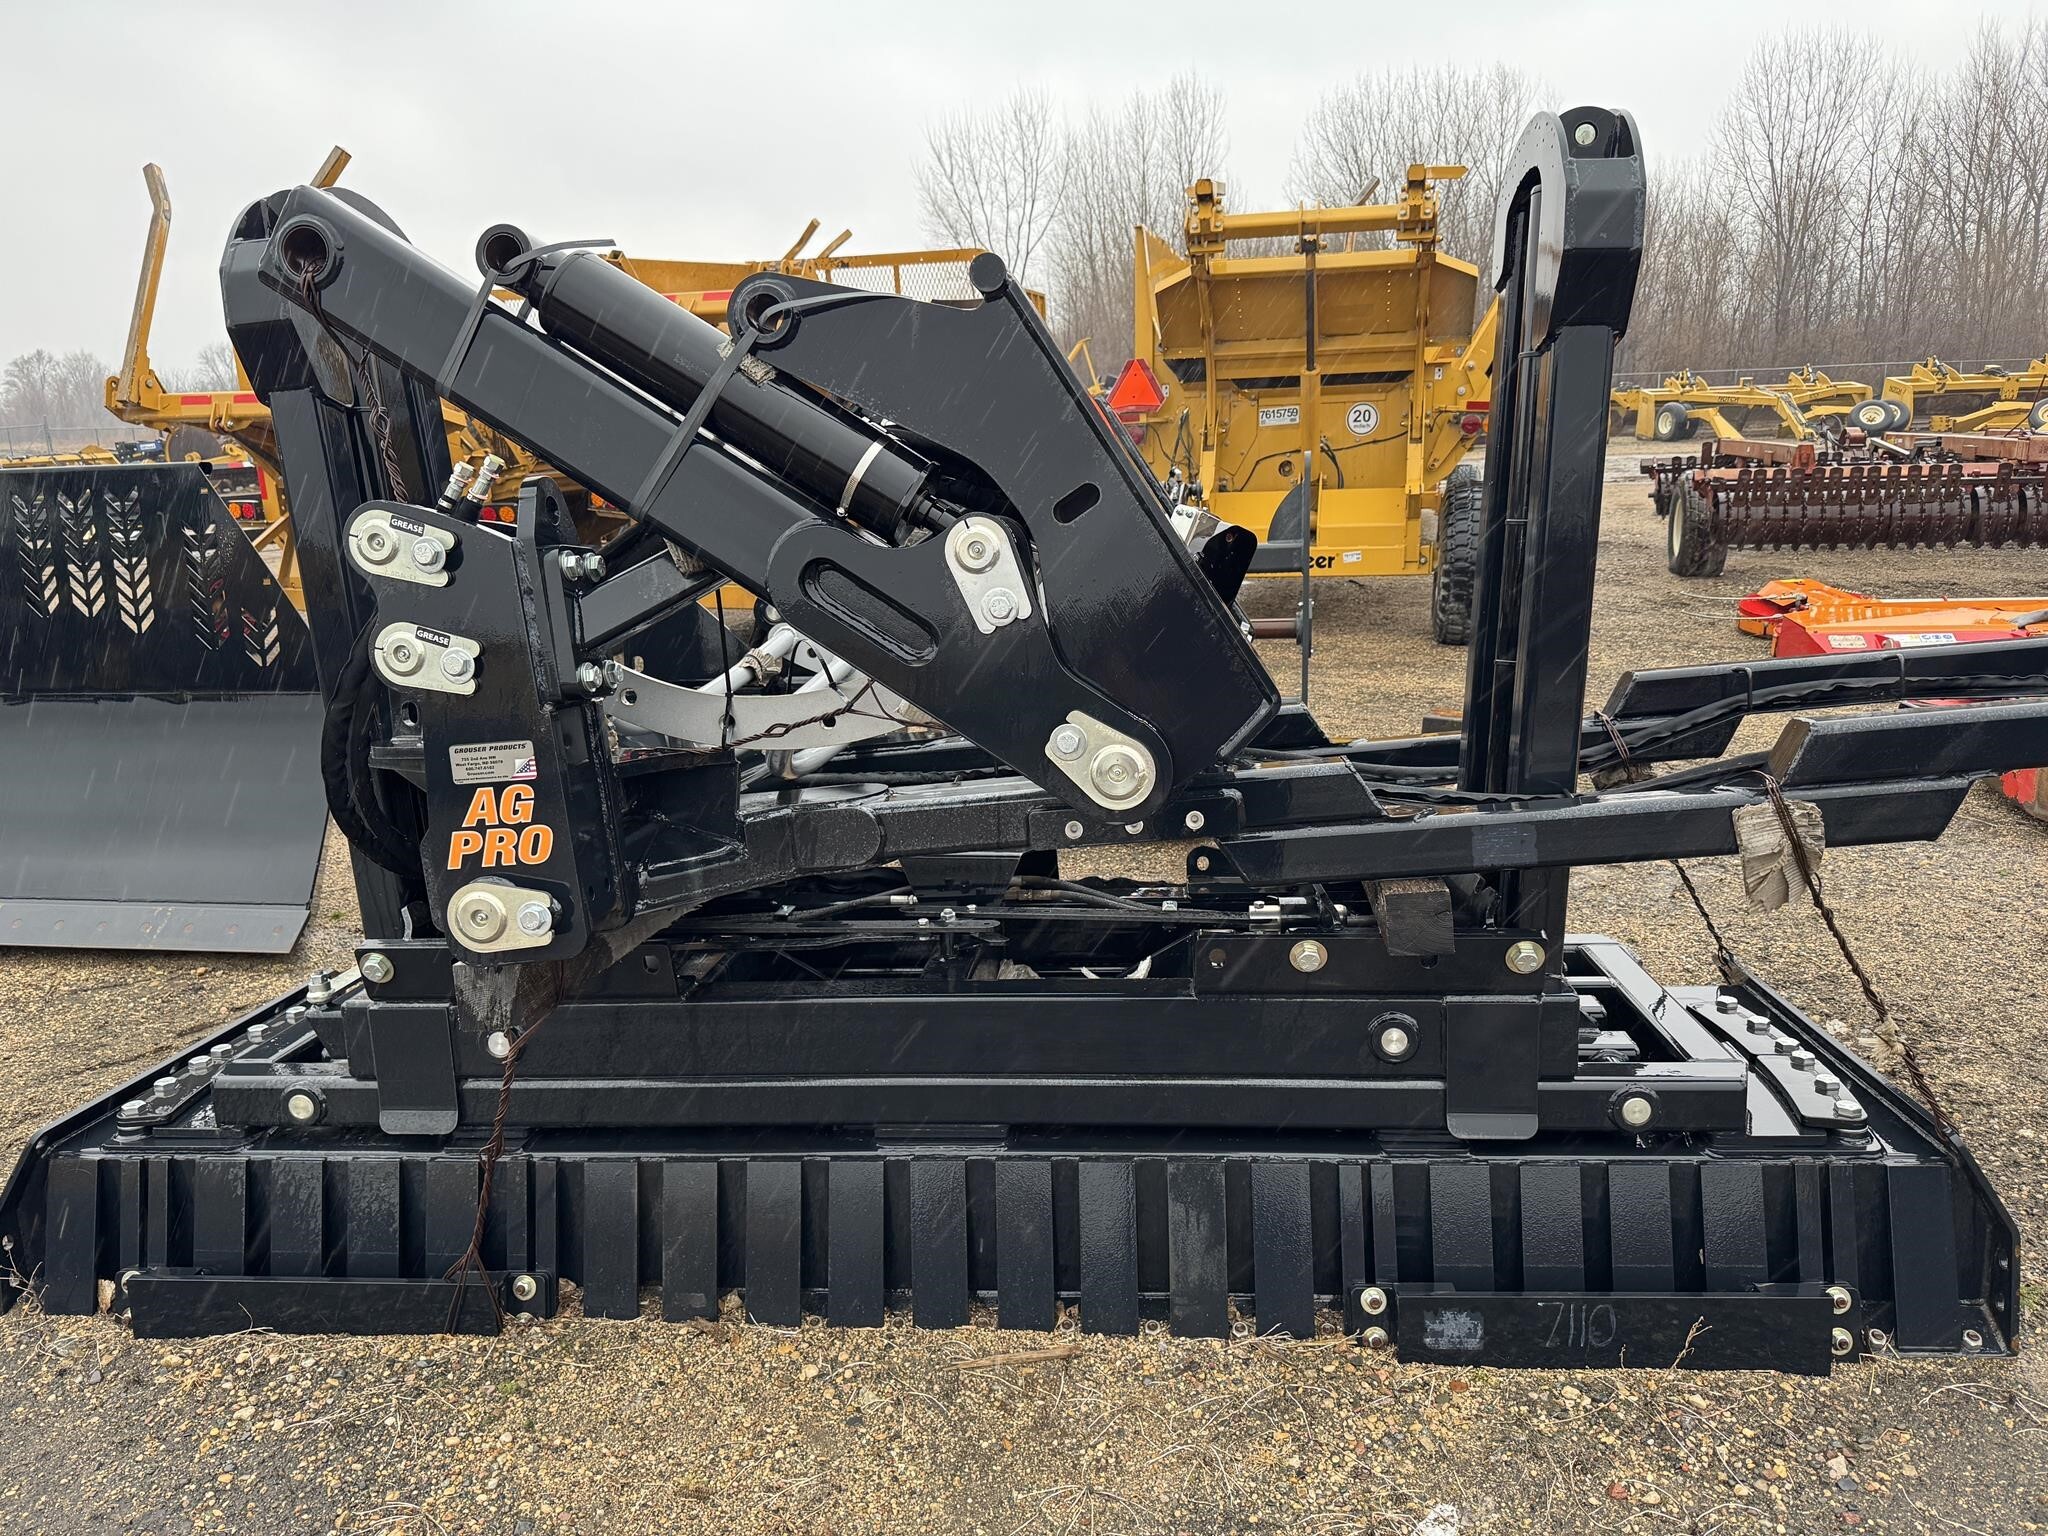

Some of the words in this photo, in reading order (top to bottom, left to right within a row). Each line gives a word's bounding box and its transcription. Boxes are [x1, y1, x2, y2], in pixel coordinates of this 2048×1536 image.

[1259, 407, 1298, 420] 7615759
[1352, 409, 1371, 423] 20
[391, 518, 424, 535] GREASE
[416, 629, 450, 646] GREASE
[454, 746, 487, 754] GROUSER
[488, 743, 526, 752] PRODUCTS
[462, 784, 535, 828] AG
[447, 824, 554, 871] PRO
